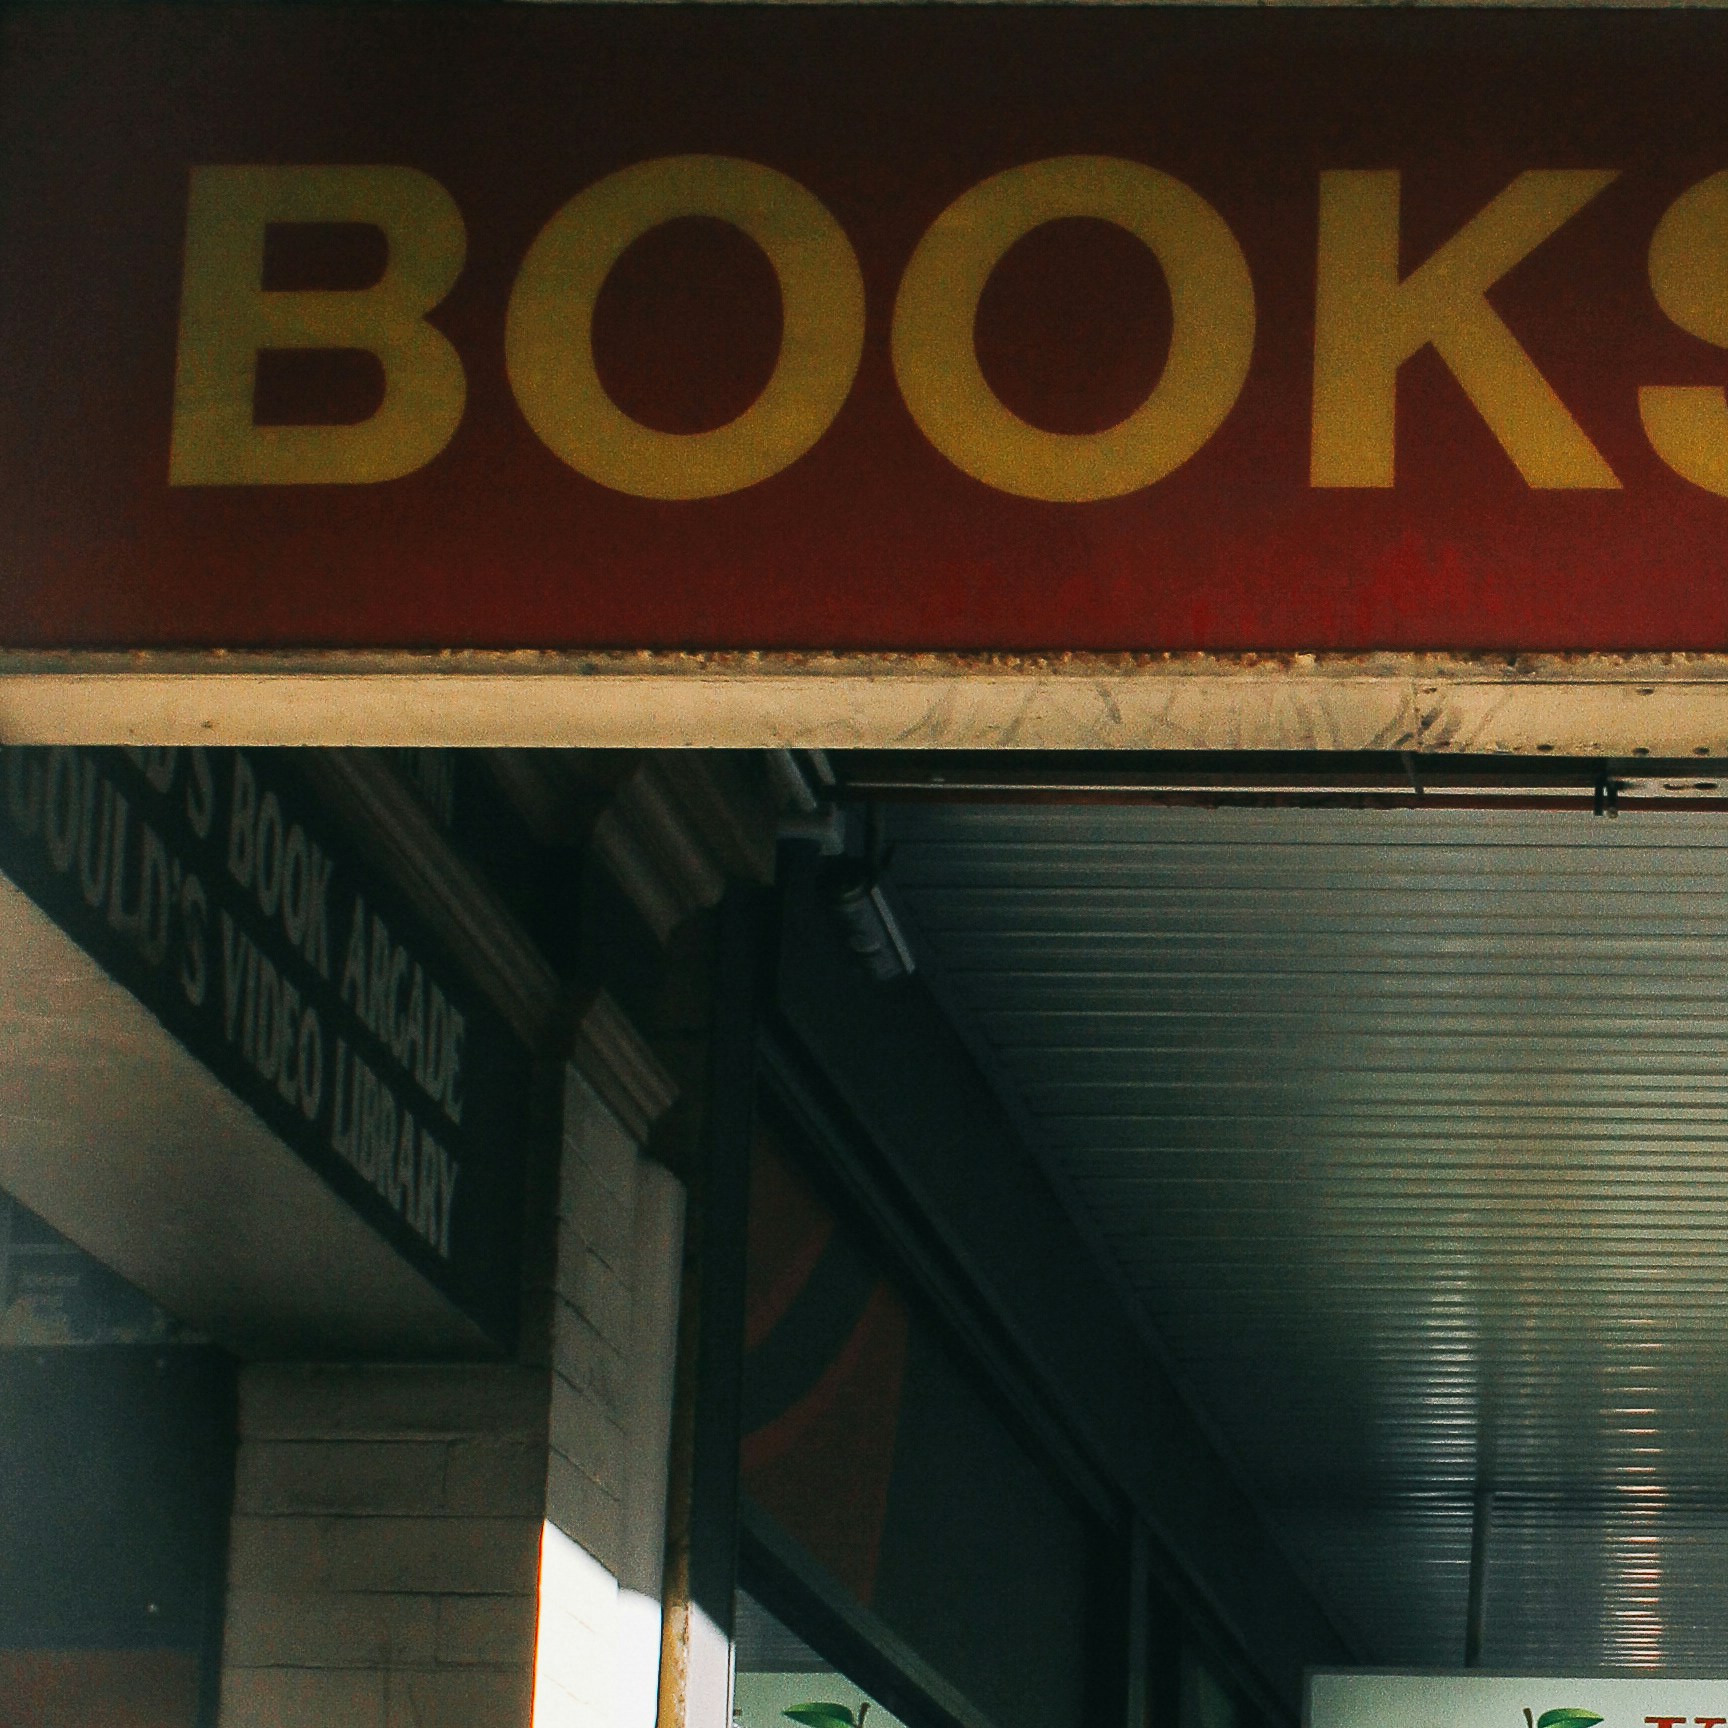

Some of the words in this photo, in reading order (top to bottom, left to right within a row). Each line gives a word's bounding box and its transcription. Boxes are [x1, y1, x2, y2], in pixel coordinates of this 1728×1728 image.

[220, 906, 325, 1121] VIDEO
[331, 1037, 459, 1260] LIBRARY
[228, 749, 334, 981] BOOK
[340, 892, 466, 1126] ARCADE
